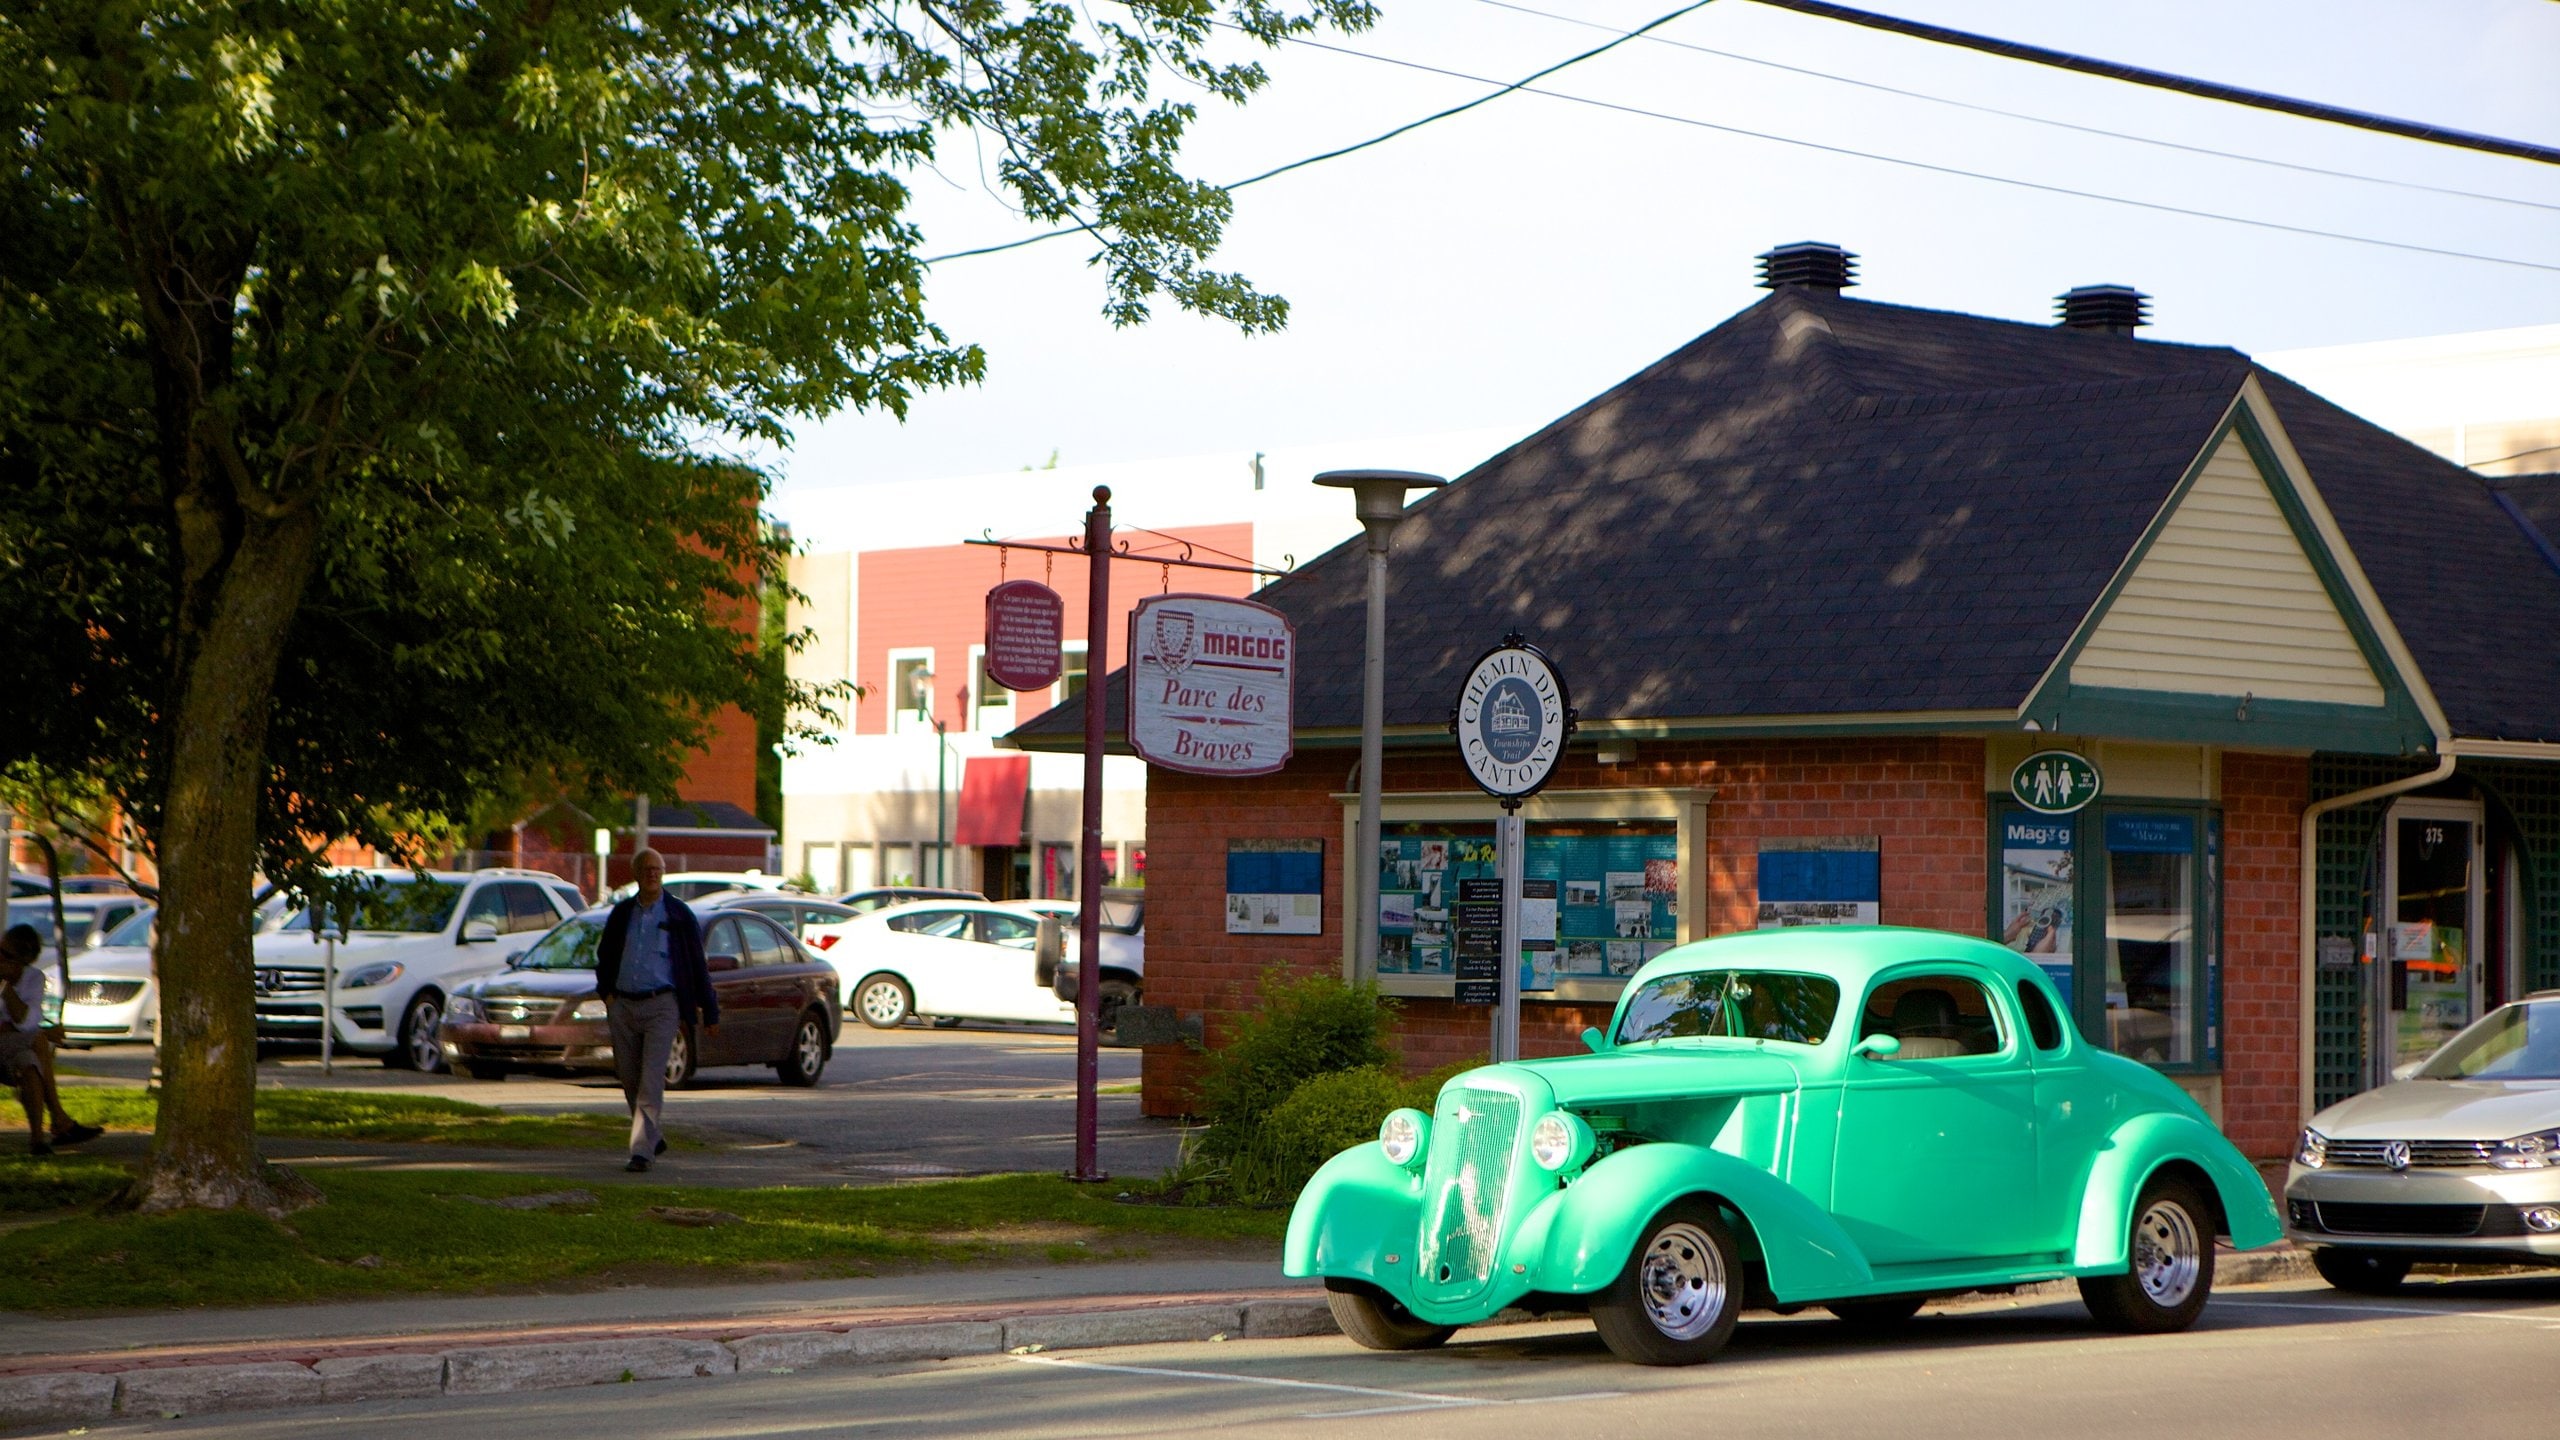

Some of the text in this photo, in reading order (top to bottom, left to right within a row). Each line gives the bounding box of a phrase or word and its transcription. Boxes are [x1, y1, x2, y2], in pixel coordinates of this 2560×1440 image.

[1204, 622, 1286, 636] VILLE DE
[1203, 632, 1285, 660] MAGOG
[1161, 678, 1265, 713] Parc des
[1464, 656, 1558, 725] CHEMIN DES
[1172, 728, 1254, 761] Braves
[1492, 737, 1531, 749] Townships
[1502, 750, 1521, 760] Trail
[1468, 737, 1554, 786] CANTONS
[2425, 827, 2444, 844] 375
[1463, 843, 1498, 863] La Ru
